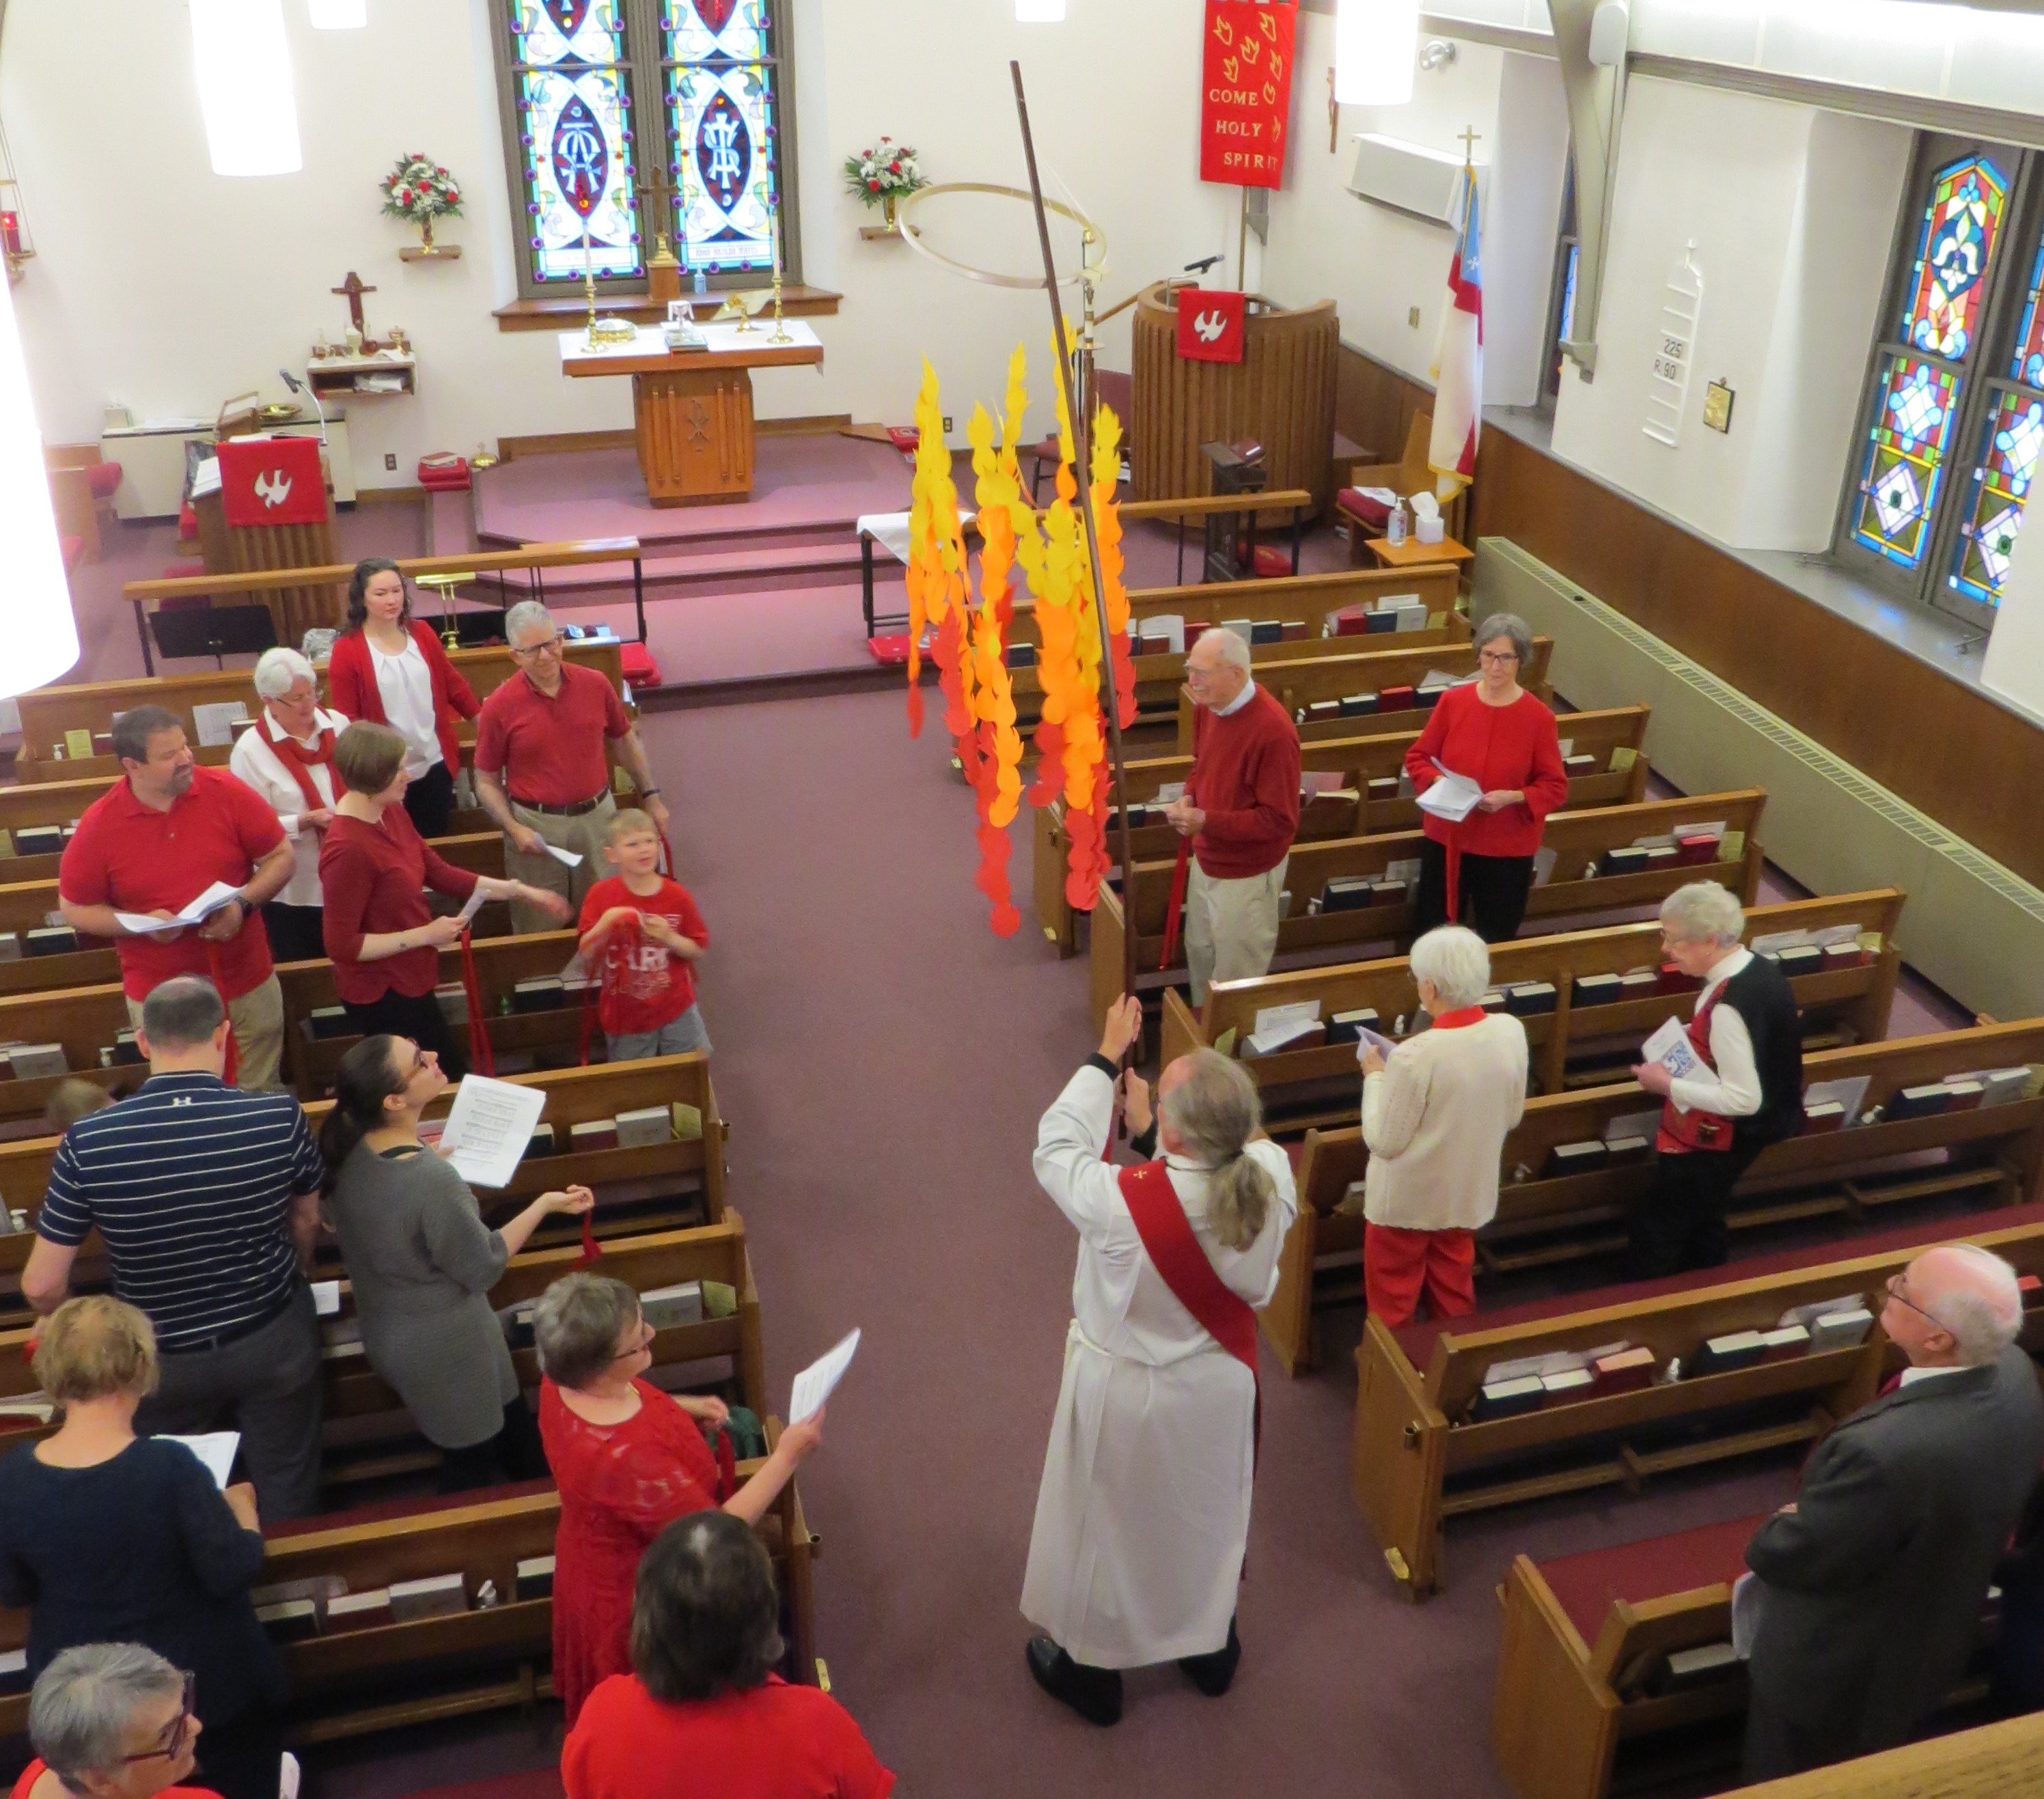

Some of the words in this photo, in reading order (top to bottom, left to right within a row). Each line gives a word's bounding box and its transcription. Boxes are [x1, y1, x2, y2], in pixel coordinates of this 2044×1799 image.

[1209, 89, 1259, 106] COME
[1215, 120, 1262, 137] HOLY
[1224, 152, 1278, 171] SPIRIT
[1664, 338, 1683, 358] 225
